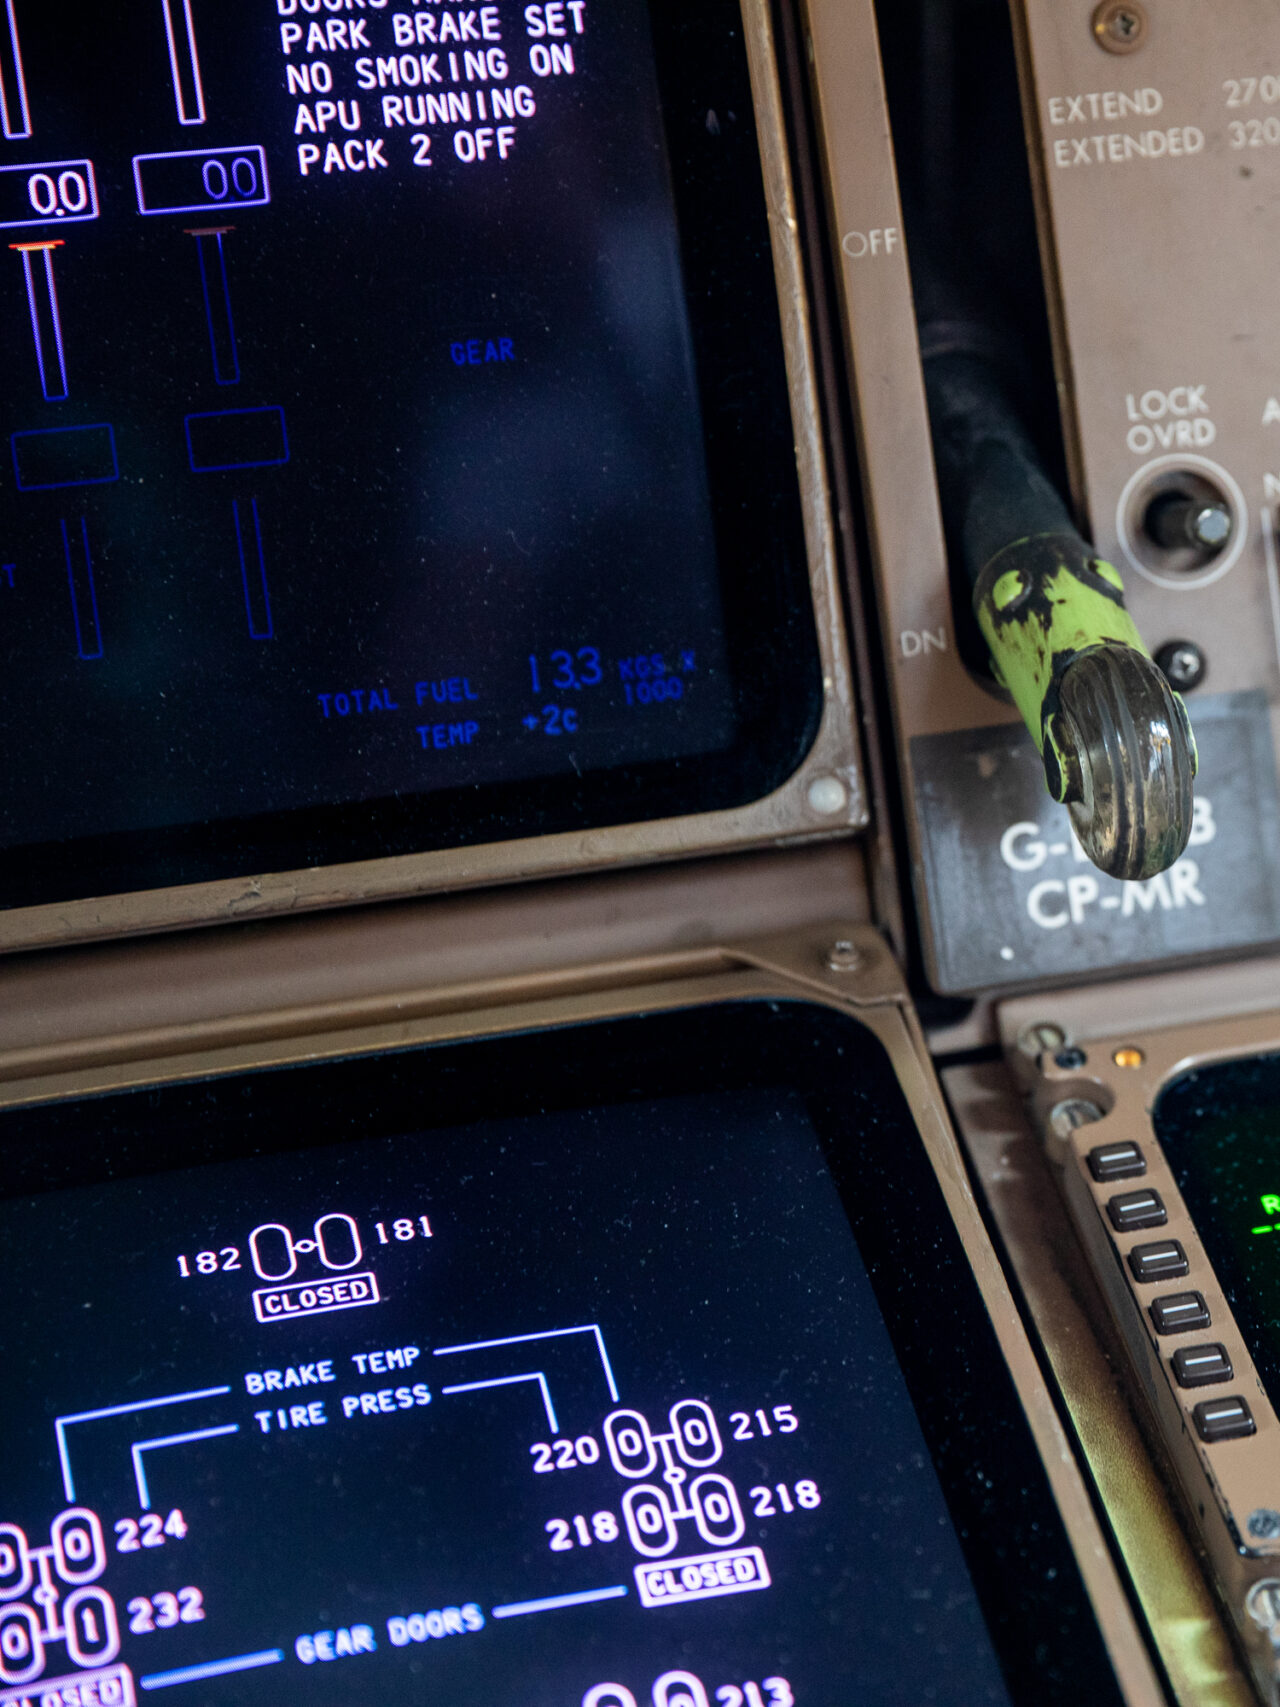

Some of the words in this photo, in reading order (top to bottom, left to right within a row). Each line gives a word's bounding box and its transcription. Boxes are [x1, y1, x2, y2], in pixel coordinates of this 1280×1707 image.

[280, 18, 371, 55] PARK
[392, 6, 502, 47] BRAKE
[524, 0, 586, 38] SET
[285, 61, 333, 95] NO
[355, 47, 509, 90] SMOKING
[529, 43, 575, 77] ON
[294, 100, 361, 135] APU
[381, 85, 537, 128] RUNNING
[1048, 87, 1164, 126] EXTEND
[297, 138, 389, 176] PACK
[410, 133, 433, 167] 2
[453, 126, 516, 163] OFF
[1053, 126, 1205, 168] EXTENDED
[27, 170, 88, 217] 0.0
[841, 227, 898, 258] OFF
[450, 337, 516, 366] GEAR
[1126, 384, 1209, 422] LOCK
[1126, 418, 1217, 455] OVRD
[901, 626, 949, 658] DN
[317, 687, 400, 719] TOTAL
[414, 676, 479, 706] FUEL
[528, 645, 602, 694] 13.3
[415, 719, 480, 750] TEMP
[1000, 796, 1217, 873] G-B
[1026, 858, 1206, 929] CP-MR
[375, 1214, 434, 1246] 181
[176, 1246, 242, 1278] 182
[264, 1279, 369, 1316] CLOSED
[244, 1359, 336, 1396] BRAKE
[352, 1345, 421, 1375] TEMP
[254, 1401, 328, 1434] TIRE
[342, 1383, 432, 1418] PRESS
[529, 1435, 600, 1473] 220
[729, 1404, 799, 1440] 215
[113, 1508, 189, 1553] 224
[545, 1510, 620, 1552] 218
[748, 1479, 822, 1517] 218
[645, 1556, 757, 1596] CLOSED
[127, 1586, 205, 1635] 232
[294, 1623, 377, 1665] GEAR
[386, 1602, 486, 1648] DOORS
